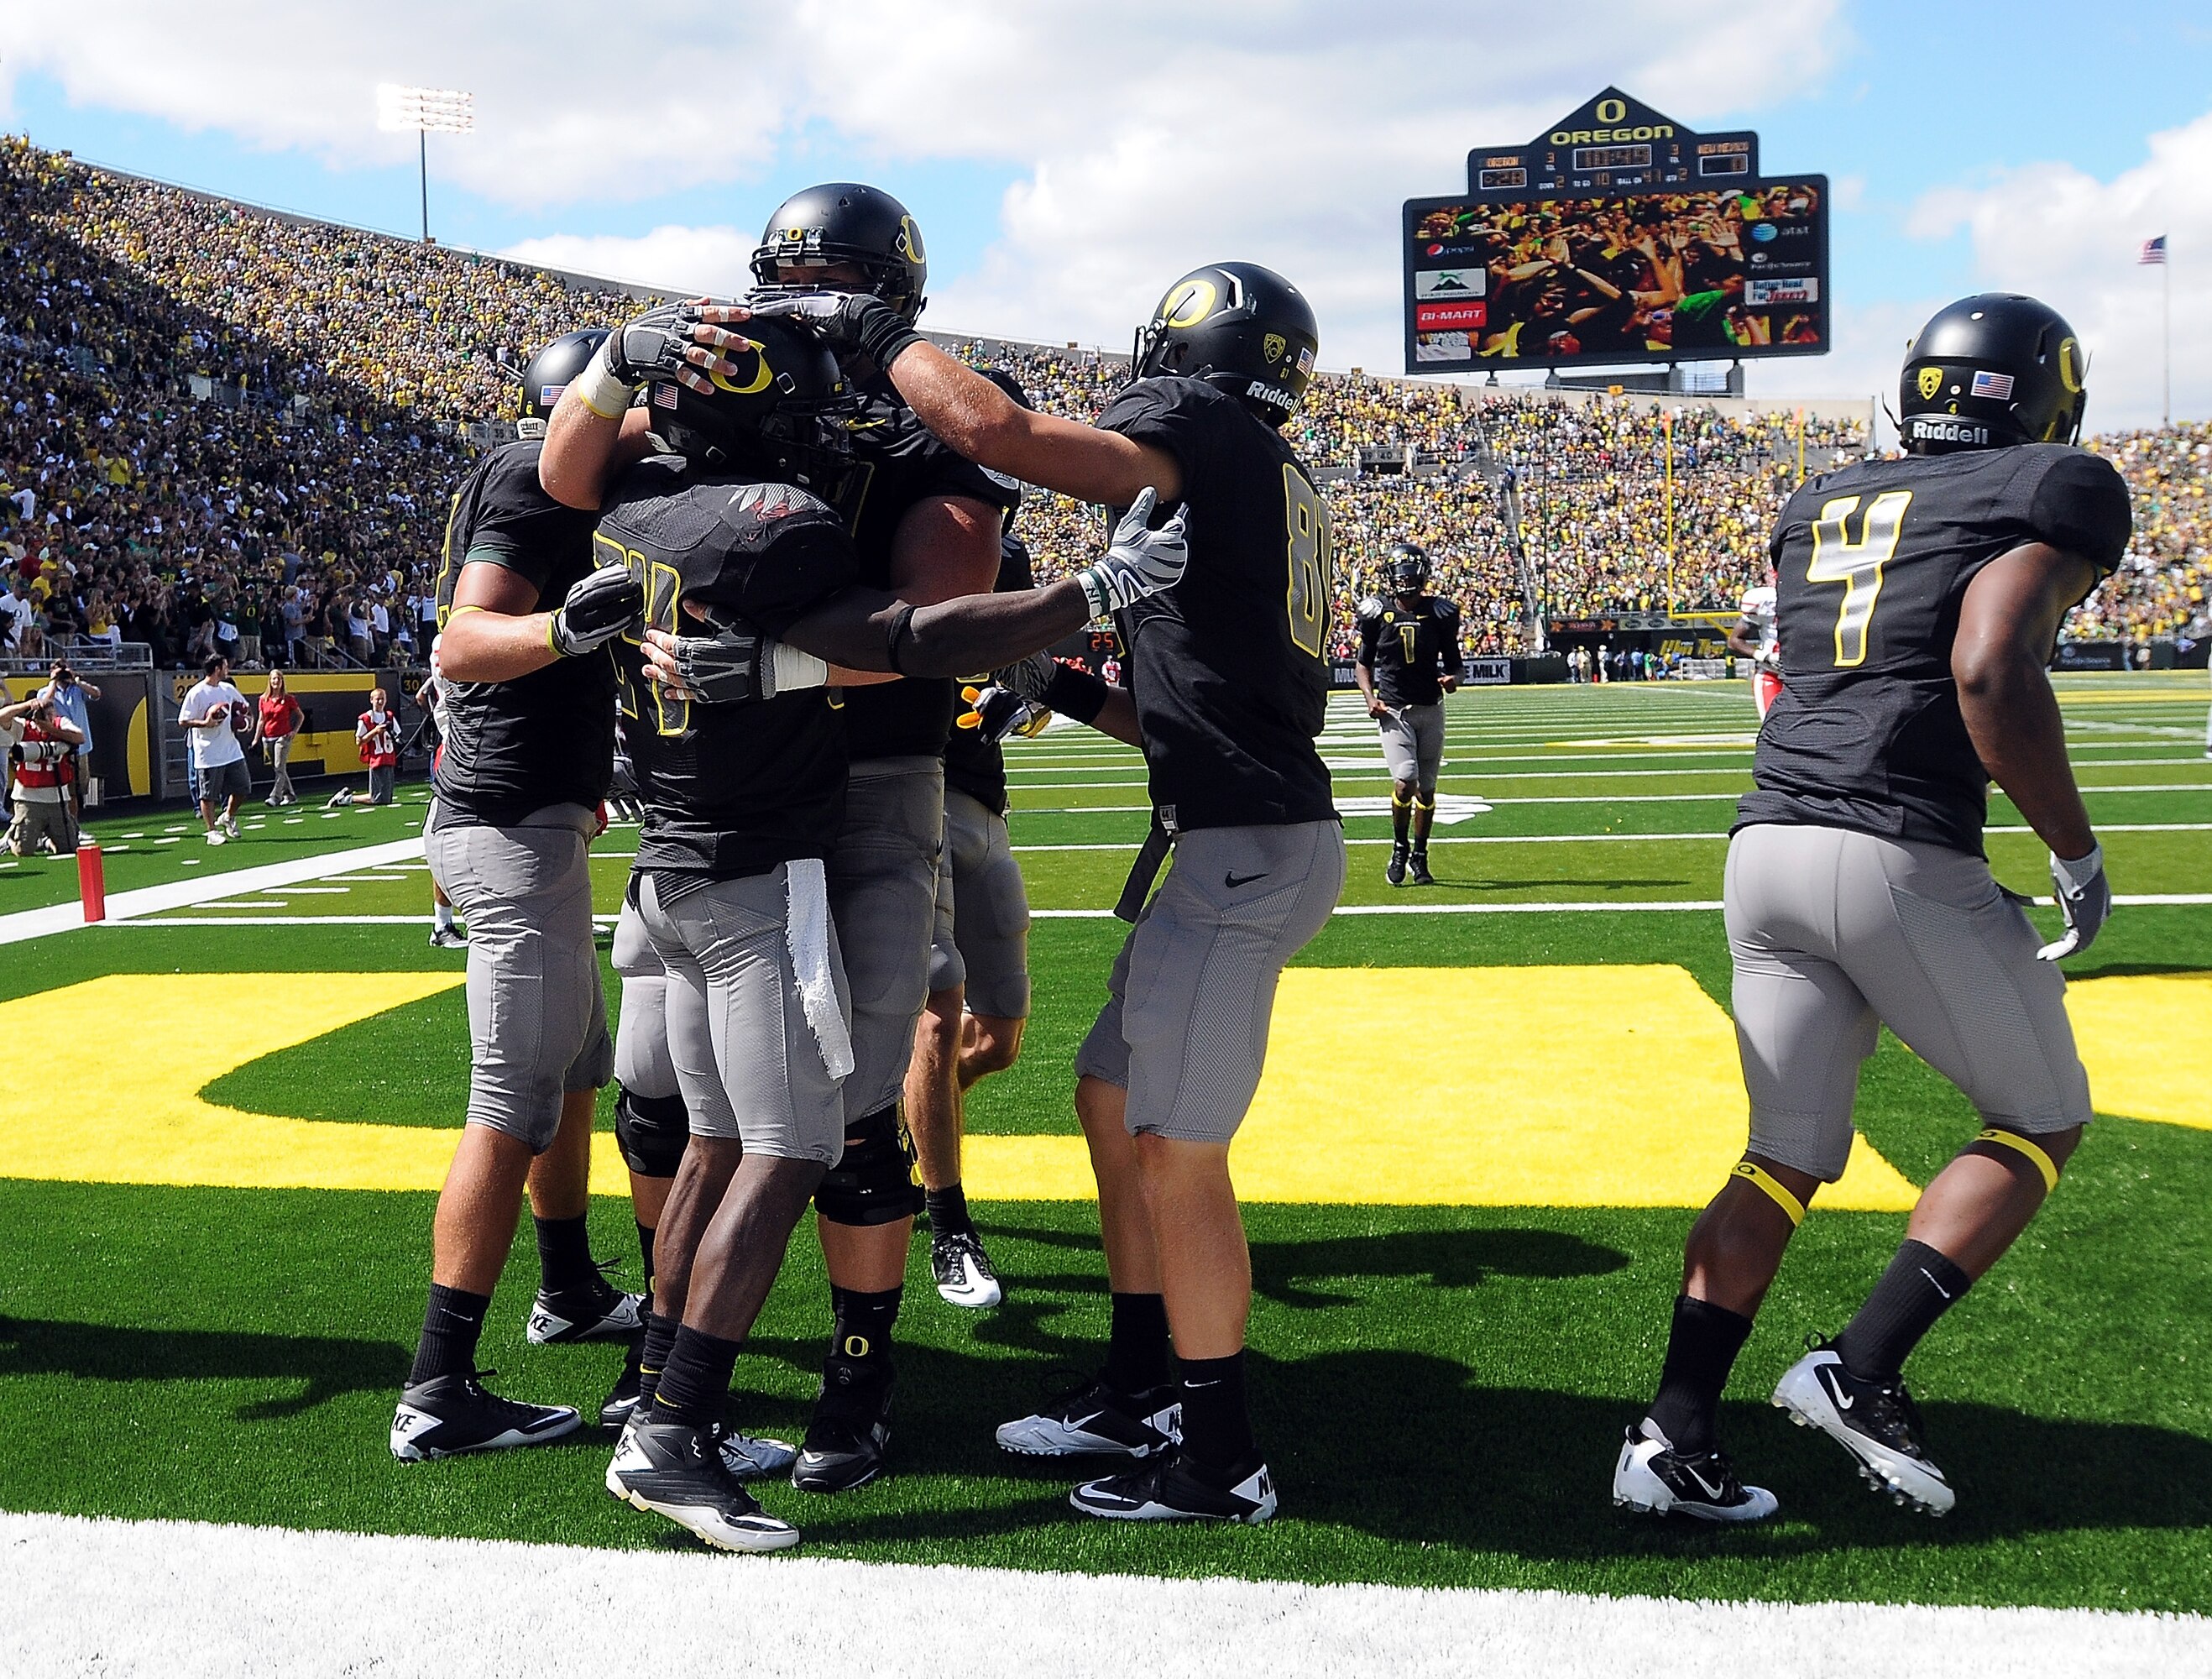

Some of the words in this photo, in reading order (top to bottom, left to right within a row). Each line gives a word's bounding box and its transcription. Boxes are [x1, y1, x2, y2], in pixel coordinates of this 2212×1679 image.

[1596, 99, 1627, 124] O
[1550, 125, 1674, 146] OREGON
[1163, 279, 1217, 328] O
[1421, 309, 1483, 321] BI-MART
[1246, 380, 1300, 415] Riddell
[1913, 421, 1989, 445] Riddell
[1806, 490, 1914, 667] 4
[1091, 632, 1114, 651] 25
[1399, 625, 1415, 664] 1
[1472, 662, 1508, 679] MILK
[404, 679, 420, 691] 30
[845, 1336, 869, 1357] O
